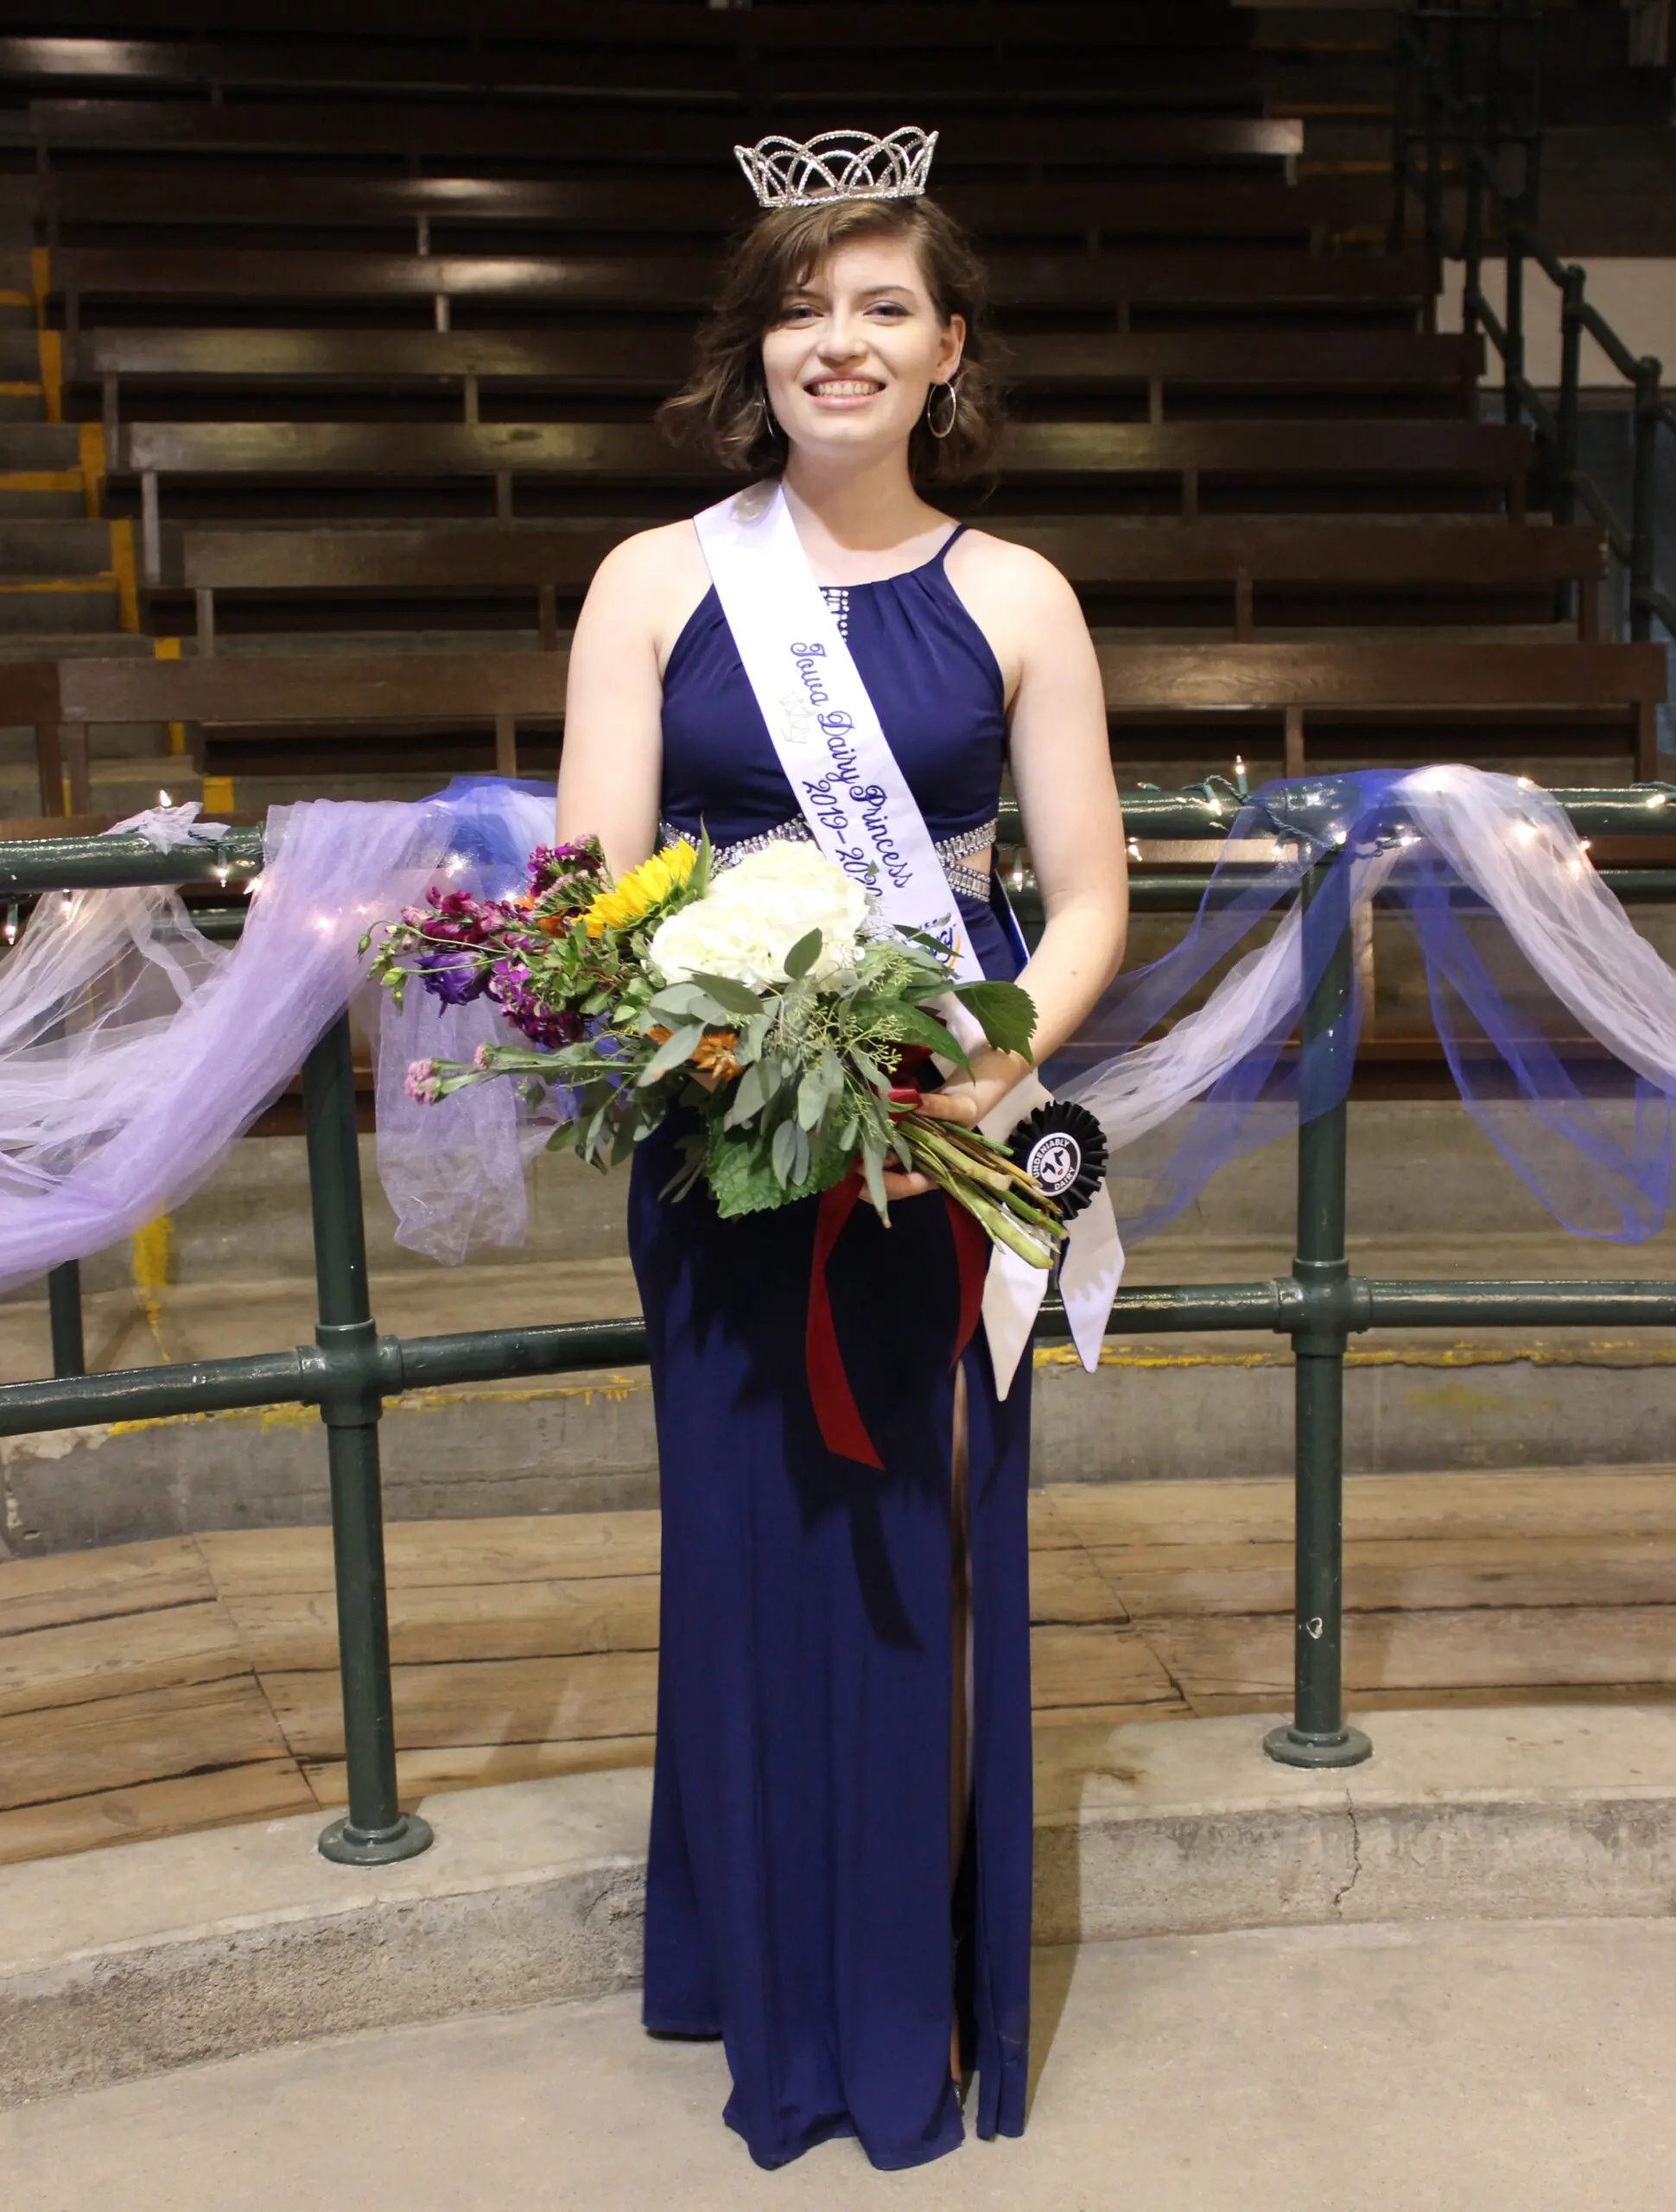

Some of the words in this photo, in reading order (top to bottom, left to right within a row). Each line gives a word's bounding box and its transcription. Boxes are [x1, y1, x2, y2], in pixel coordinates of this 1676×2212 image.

[790, 642, 828, 706] Iowa
[816, 710, 860, 784] Dairy
[849, 785, 913, 888] Princess
[1032, 1137, 1070, 1178] UNDENIABLY
[1054, 1166, 1076, 1191] DAIRY
